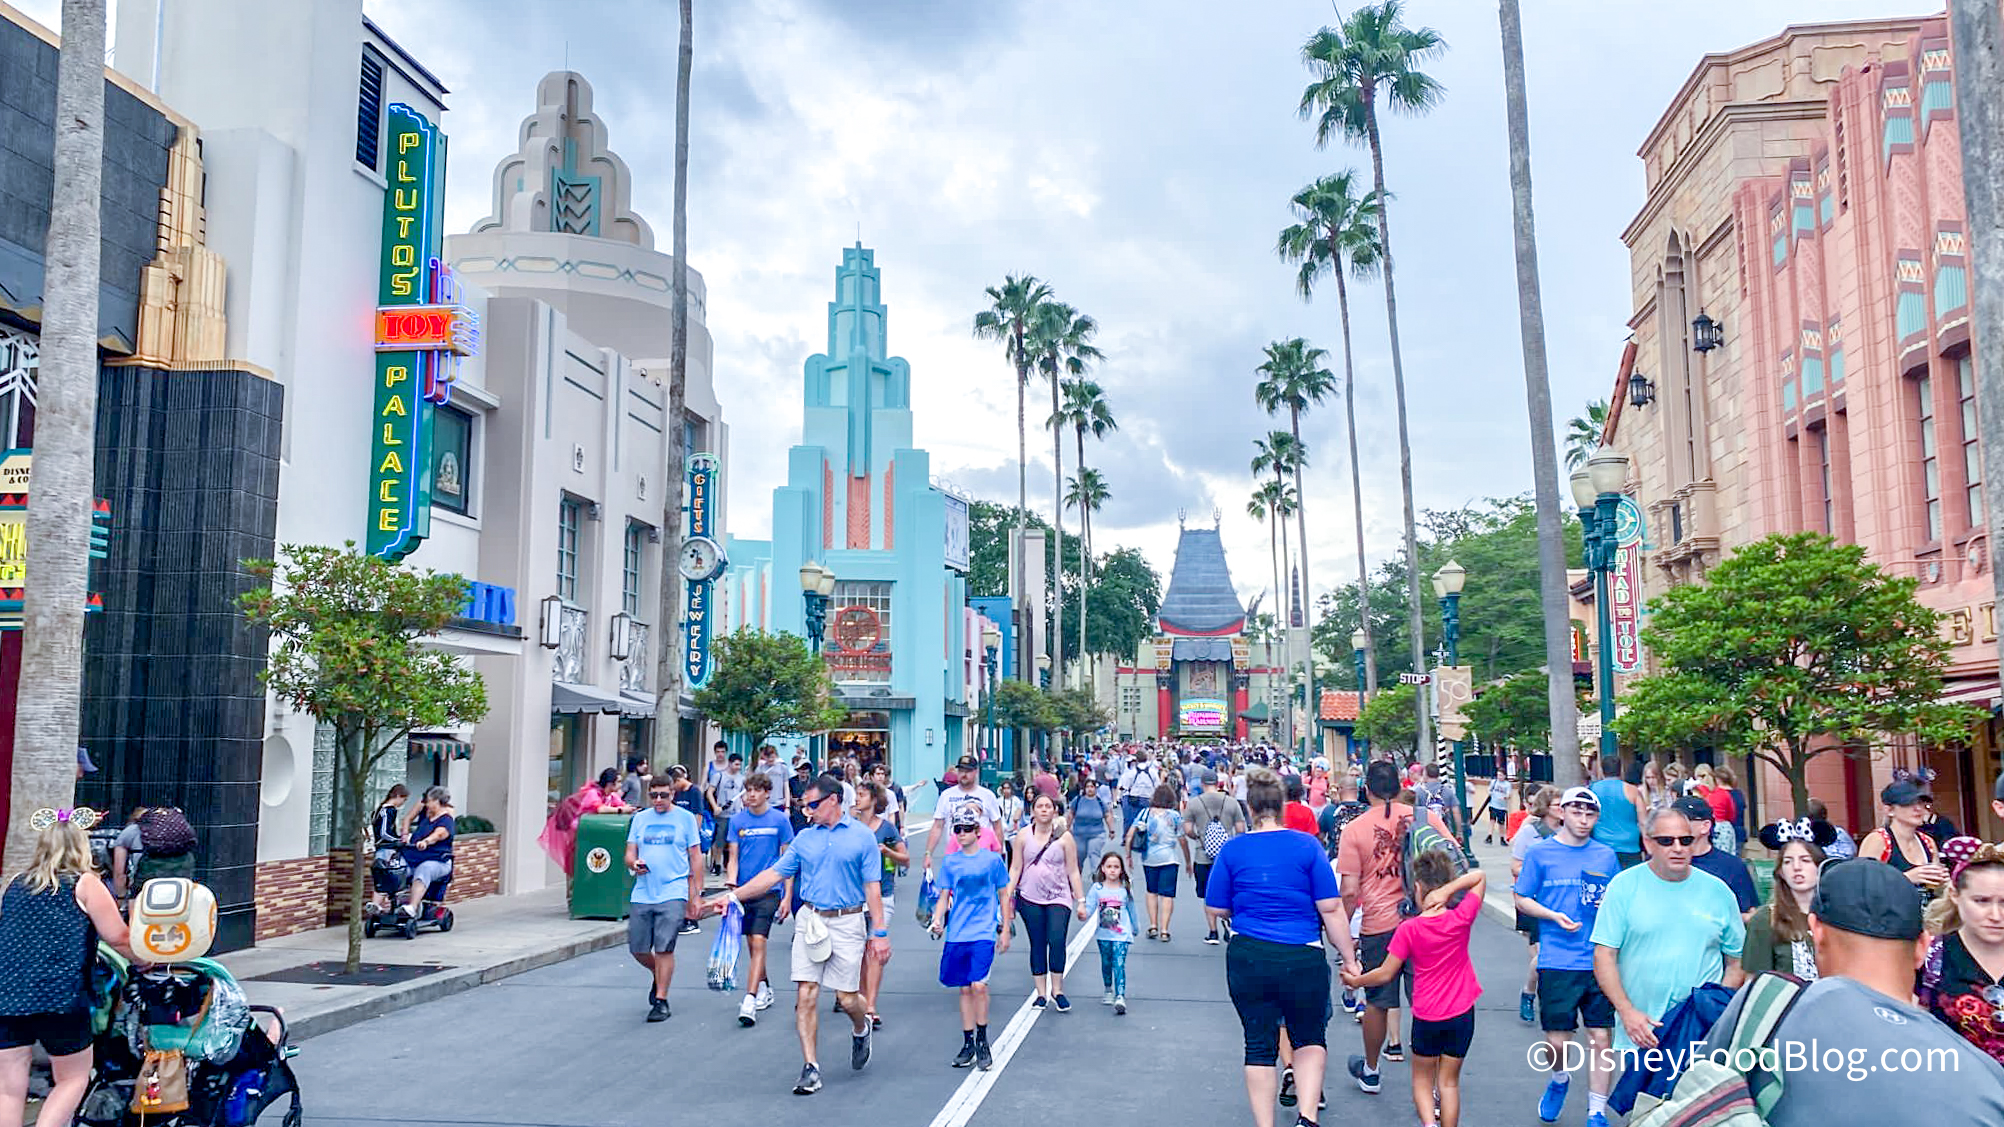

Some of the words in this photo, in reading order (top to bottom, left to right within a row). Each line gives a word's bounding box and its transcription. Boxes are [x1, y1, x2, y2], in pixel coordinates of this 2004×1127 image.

[391, 132, 420, 296] PLUTO'S
[382, 313, 449, 340] TOY
[379, 366, 408, 531] PALACE
[693, 473, 705, 533] GIFTS
[689, 584, 705, 676] JEWELRY
[1618, 620, 1634, 662] TOE
[1400, 673, 1426, 684] STOP
[1441, 679, 1469, 710] 50
